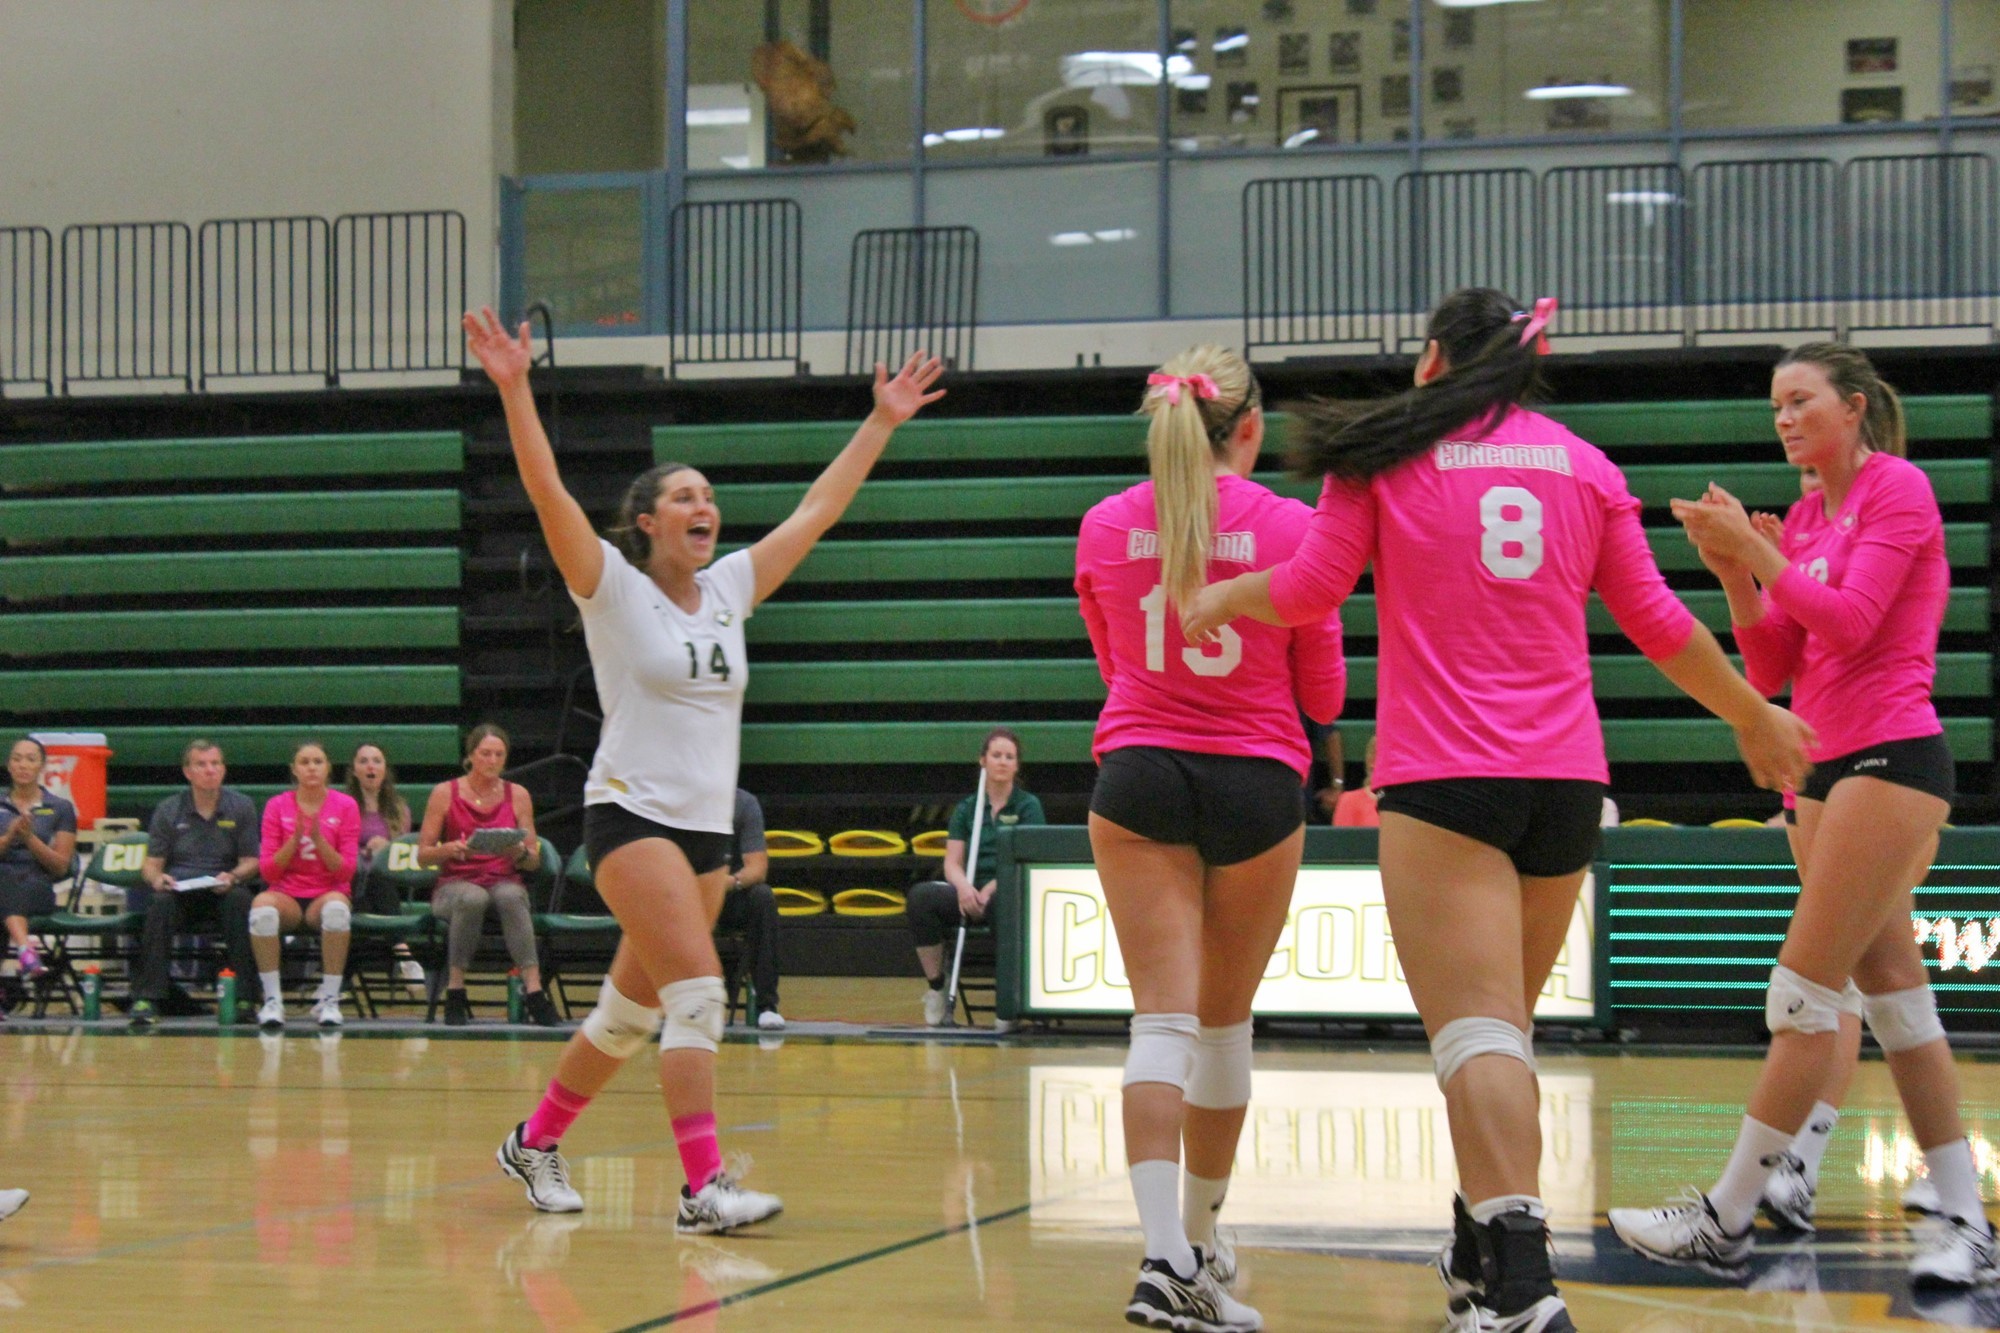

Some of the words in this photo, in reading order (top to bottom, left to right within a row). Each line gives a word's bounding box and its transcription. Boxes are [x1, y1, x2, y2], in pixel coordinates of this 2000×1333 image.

[1435, 440, 1573, 477] CONCORDIA
[1127, 528, 1256, 564] CODIA
[1479, 486, 1543, 579] 8
[684, 641, 731, 682] 14
[300, 835, 317, 860] 2
